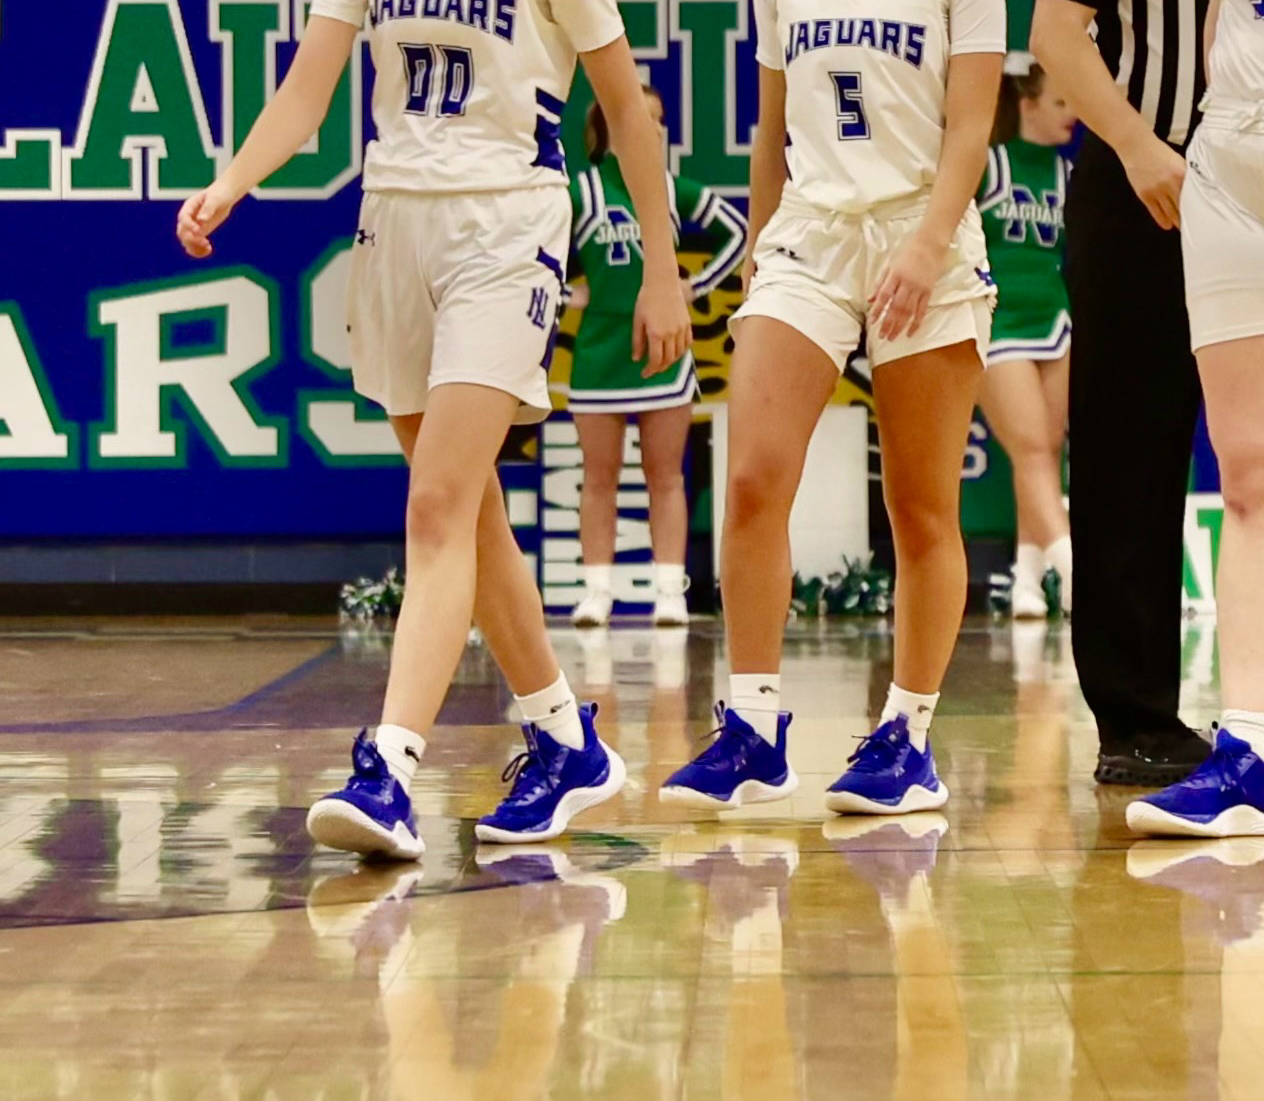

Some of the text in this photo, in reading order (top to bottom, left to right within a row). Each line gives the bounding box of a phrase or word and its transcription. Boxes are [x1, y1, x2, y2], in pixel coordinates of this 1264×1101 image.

[785, 18, 927, 70] JAGUARS
[397, 42, 474, 118] 00
[828, 71, 871, 141] 5
[993, 201, 1065, 229] JAGUAR
